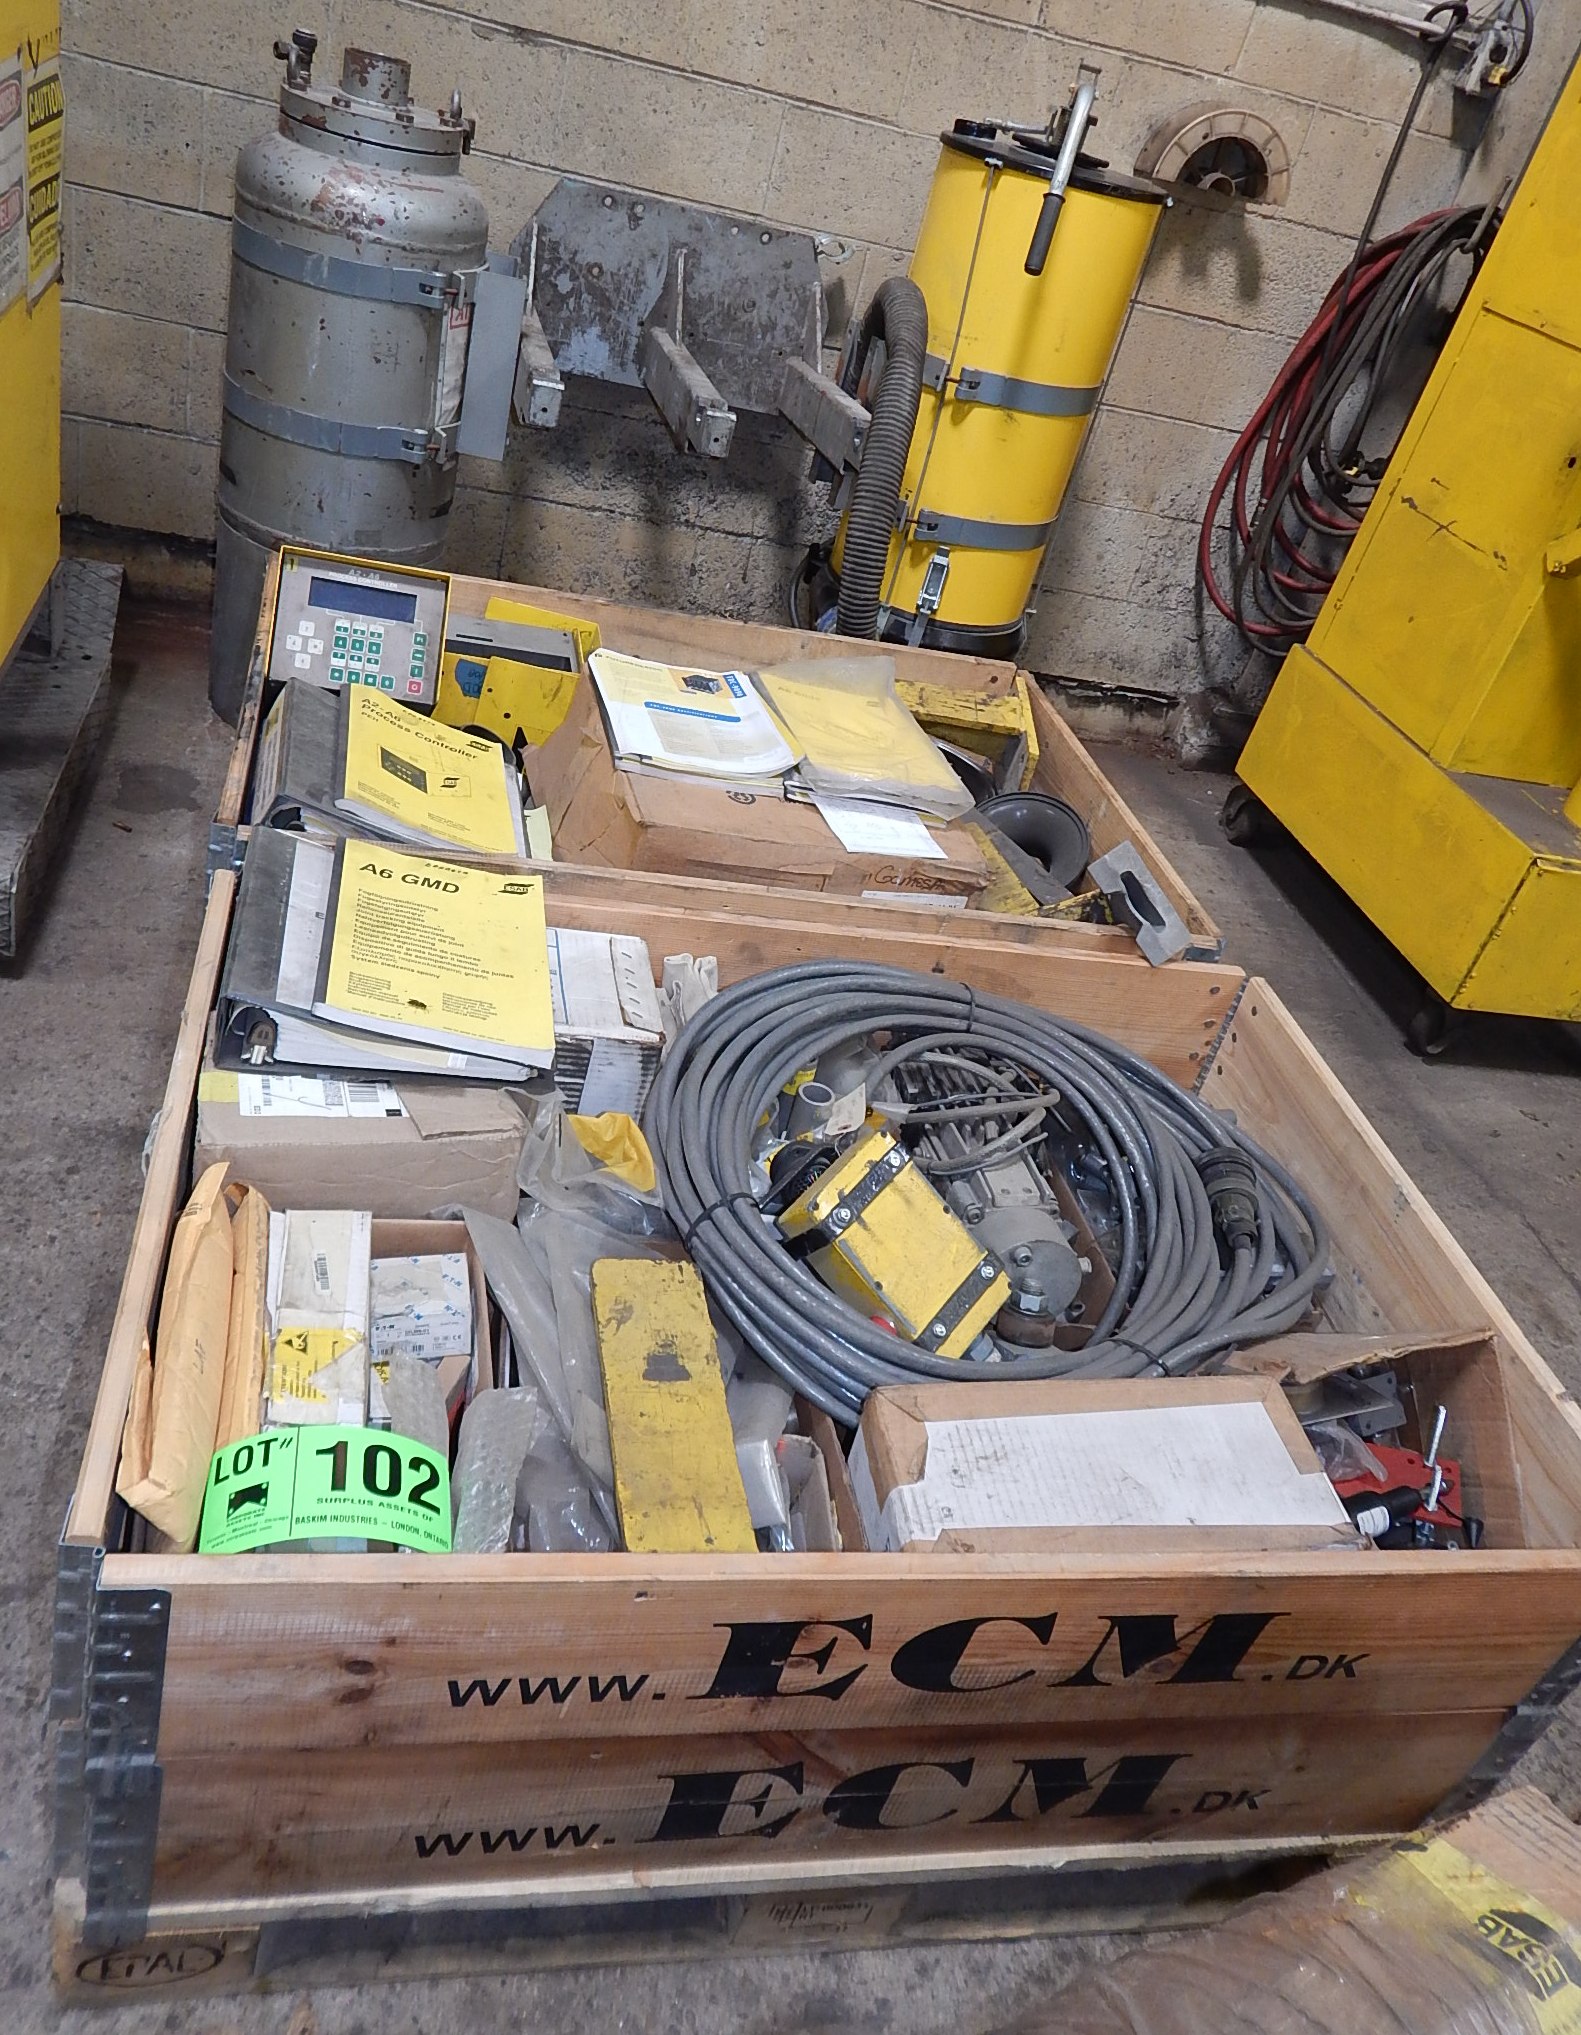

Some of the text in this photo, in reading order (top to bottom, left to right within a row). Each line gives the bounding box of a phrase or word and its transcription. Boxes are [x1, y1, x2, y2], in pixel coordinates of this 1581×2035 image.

[361, 703, 411, 733] Process
[414, 731, 478, 759] Controller
[359, 863, 460, 894] A6 GMD
[315, 1440, 441, 1516] 102
[316, 1497, 374, 1507] SURPLUS
[378, 1502, 419, 1517] ASSETS
[294, 1514, 328, 1525] BASKIM
[330, 1515, 379, 1526] INDUSTRIES
[423, 1530, 450, 1551] ONTARIO
[1477, 1914, 1569, 1998] ESAB
